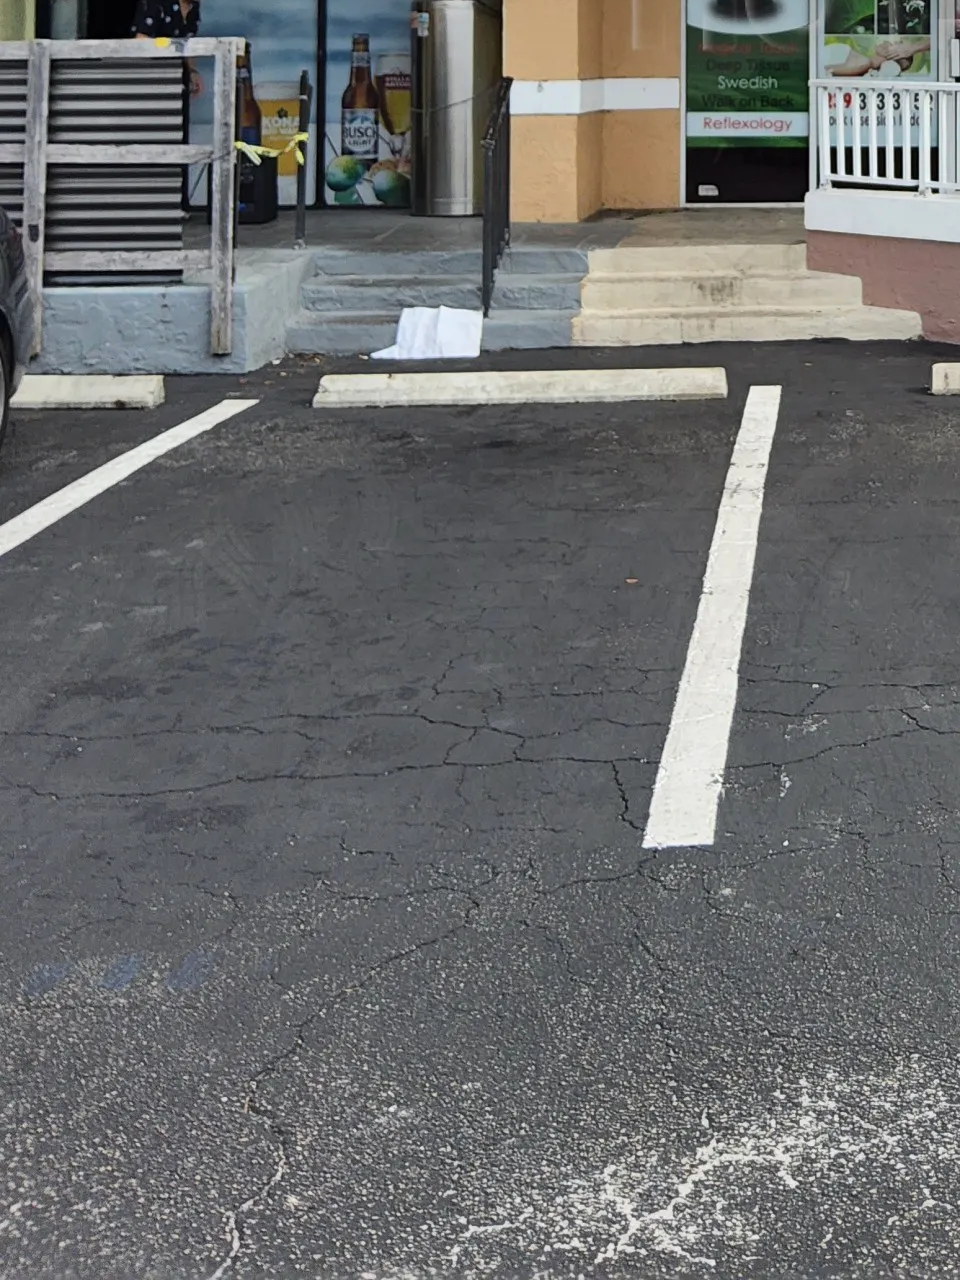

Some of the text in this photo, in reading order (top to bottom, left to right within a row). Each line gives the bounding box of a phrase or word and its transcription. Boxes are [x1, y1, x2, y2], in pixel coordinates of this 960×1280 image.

[717, 75, 778, 89] Swedish
[702, 95, 794, 108] Walk on Back
[703, 117, 793, 132] Reflexology
